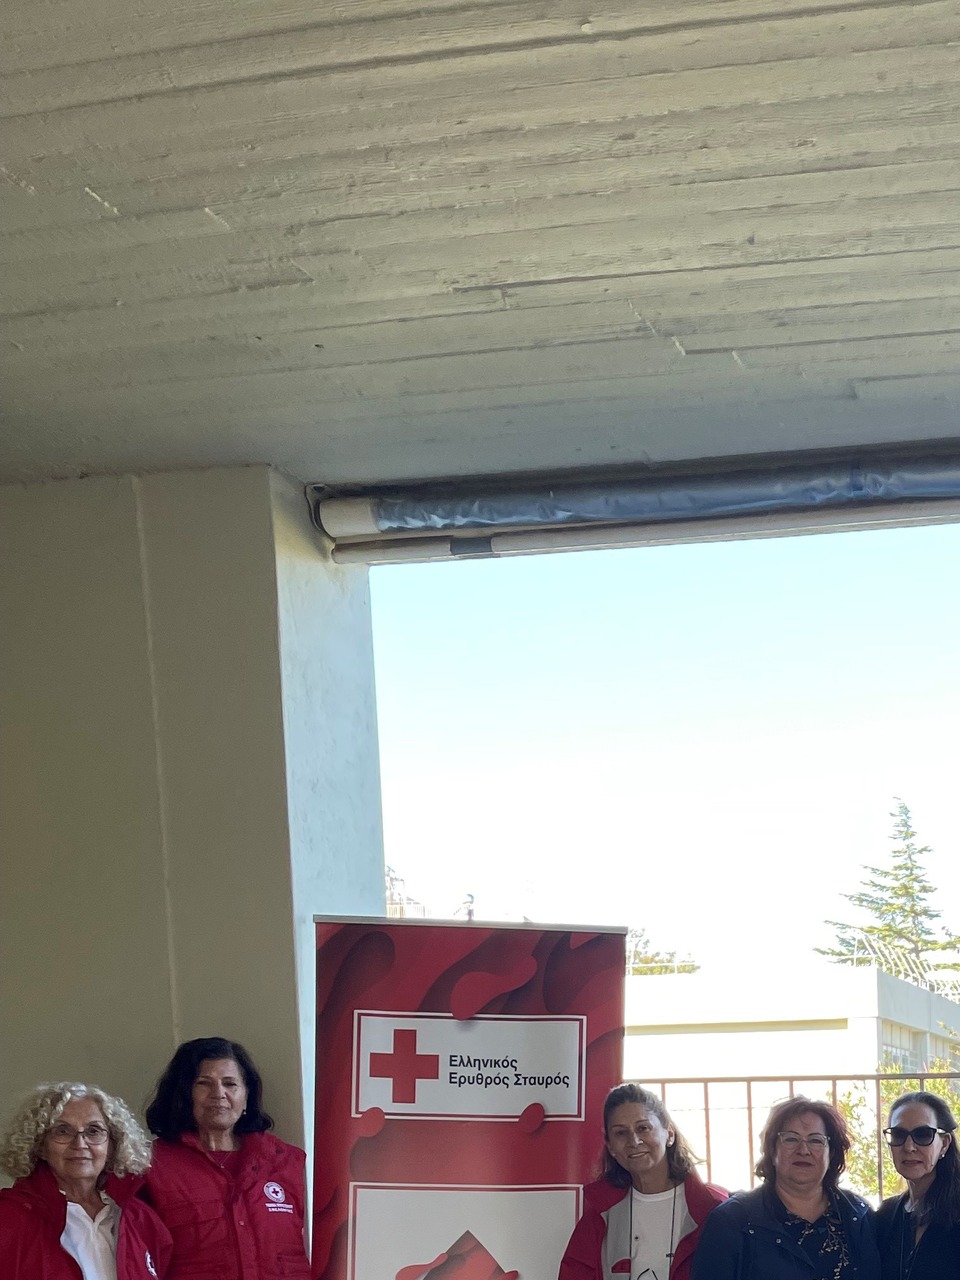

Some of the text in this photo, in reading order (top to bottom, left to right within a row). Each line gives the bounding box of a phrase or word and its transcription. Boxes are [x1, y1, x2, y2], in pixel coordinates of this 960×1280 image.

[449, 1055, 518, 1072] Ελληνικός
[449, 1072, 570, 1089] Ερυθρός Σταυρός
